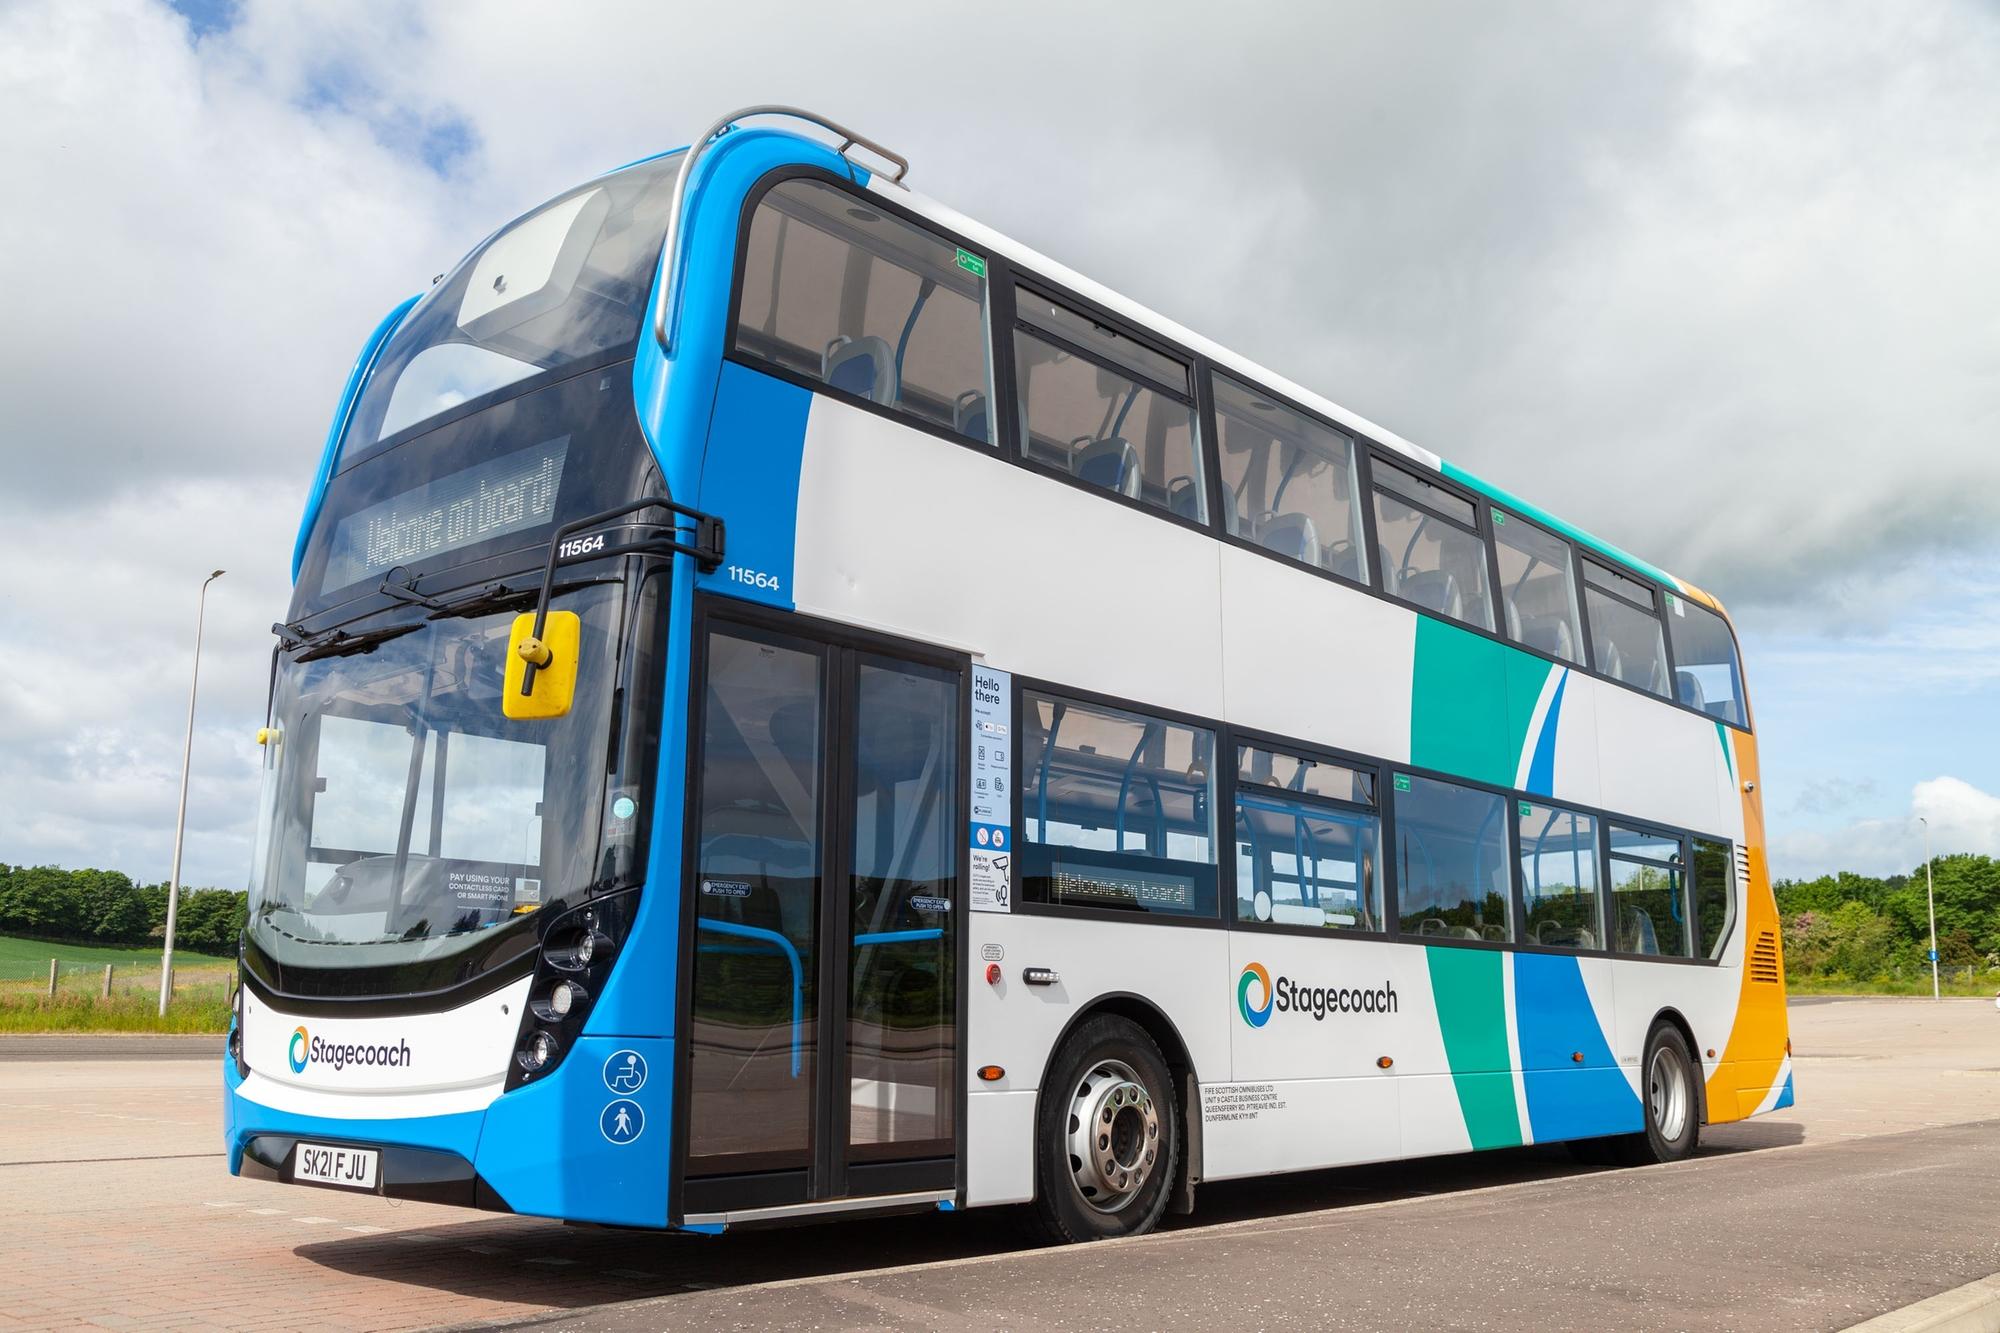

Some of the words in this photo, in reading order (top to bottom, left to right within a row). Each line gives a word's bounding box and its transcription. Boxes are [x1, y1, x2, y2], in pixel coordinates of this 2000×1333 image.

[448, 498, 473, 542] on
[559, 535, 604, 558] 11564
[728, 566, 780, 591] 11564
[975, 675, 1000, 692] Hello
[975, 689, 1000, 704] there
[448, 883, 492, 892] CONTACTLESS
[449, 873, 465, 881] PAY
[466, 874, 489, 883] USING
[491, 876, 510, 885] YOUR
[1058, 872, 1118, 896] Welcome
[1122, 883, 1138, 899] on
[468, 892, 488, 900] SMART
[1276, 976, 1398, 1021] Stagecoach
[310, 1035, 411, 1071] Stagecoach
[1215, 1086, 1238, 1094] SCOTTISH
[1221, 1095, 1238, 1103] CASTLE
[1239, 1094, 1260, 1102] BUSINESS
[1261, 1093, 1277, 1101] CENTRE
[303, 1149, 333, 1177] SK21
[335, 1152, 366, 1180] FJU
